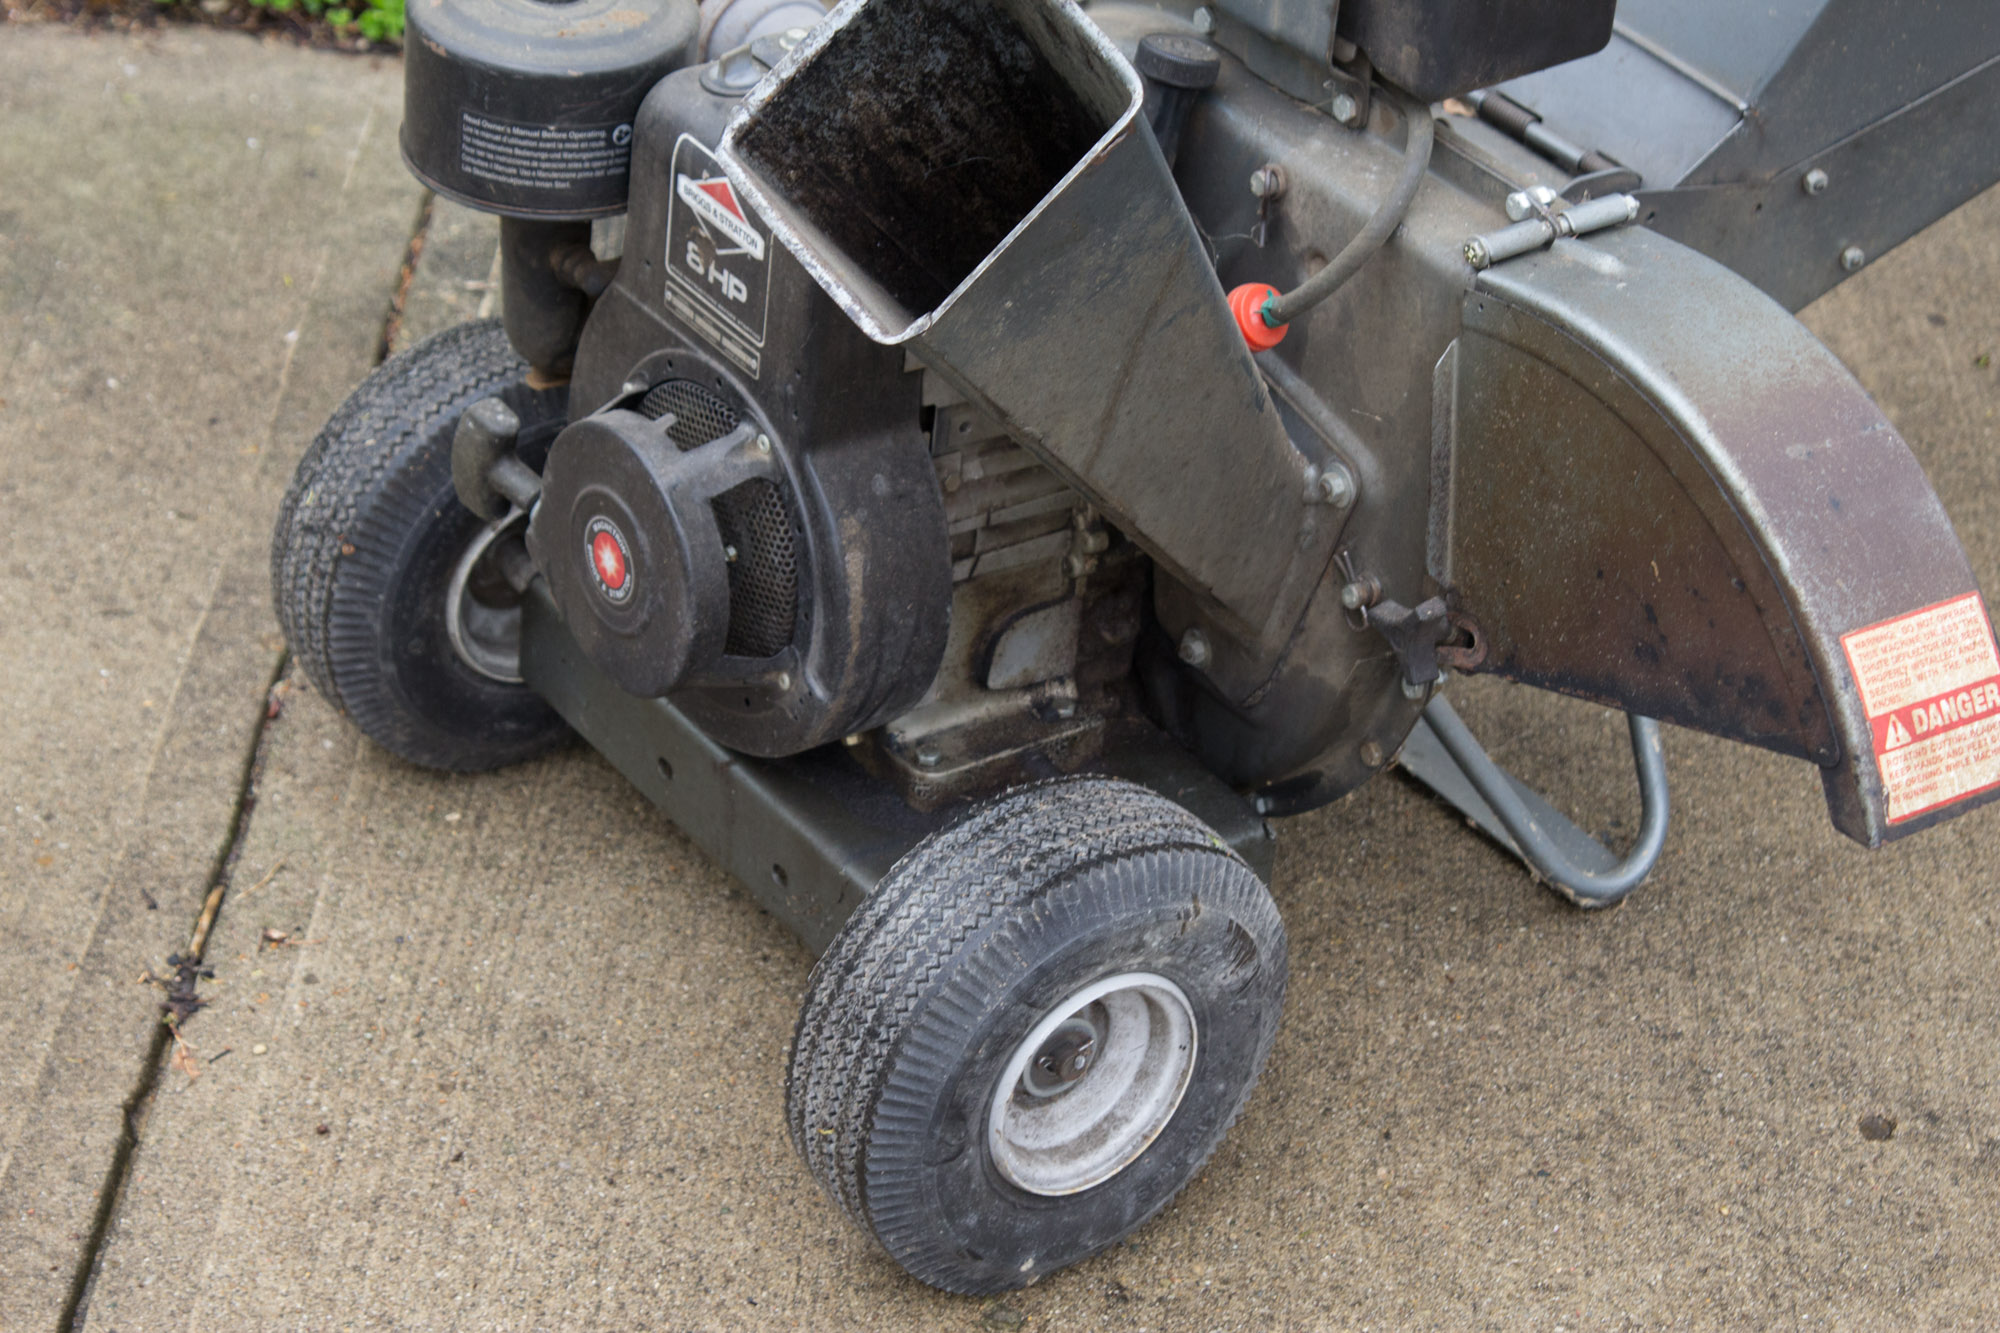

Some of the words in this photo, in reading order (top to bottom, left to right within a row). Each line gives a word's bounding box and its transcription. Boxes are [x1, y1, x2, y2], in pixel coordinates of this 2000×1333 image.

[463, 113, 481, 126] Read
[512, 126, 540, 138] Manual
[541, 130, 567, 139] Before
[683, 184, 712, 214] BRIGGS
[712, 207, 719, 219] &
[719, 212, 759, 249] STRATTON
[707, 259, 748, 303] HP
[1880, 634, 1921, 653] MACHINE
[1959, 615, 1980, 628] THE
[1916, 615, 1934, 629] NOT
[1936, 603, 1976, 623] OPERATE
[1960, 625, 1983, 641] BEEN
[1865, 664, 1909, 687] PROPERLY
[1911, 647, 1957, 671] INSTALLED
[1958, 640, 1977, 656] AND
[1869, 678, 1912, 698] SECURED
[1916, 668, 1940, 683] WITH
[1942, 659, 1961, 674] THE
[1911, 681, 2000, 736] DANGER
[1887, 744, 1929, 768] ROTATING
[1930, 734, 1967, 753] CUTTING
[1969, 720, 2000, 738] BLADE
[1889, 765, 1914, 781] KEEP
[1946, 746, 1964, 761] AND
[1966, 737, 1989, 752] FEET
[1891, 781, 1908, 793] OF
[1908, 766, 1944, 787] OPENING
[1945, 755, 1971, 774] WHILE
[1907, 782, 1938, 800] RUNNING
